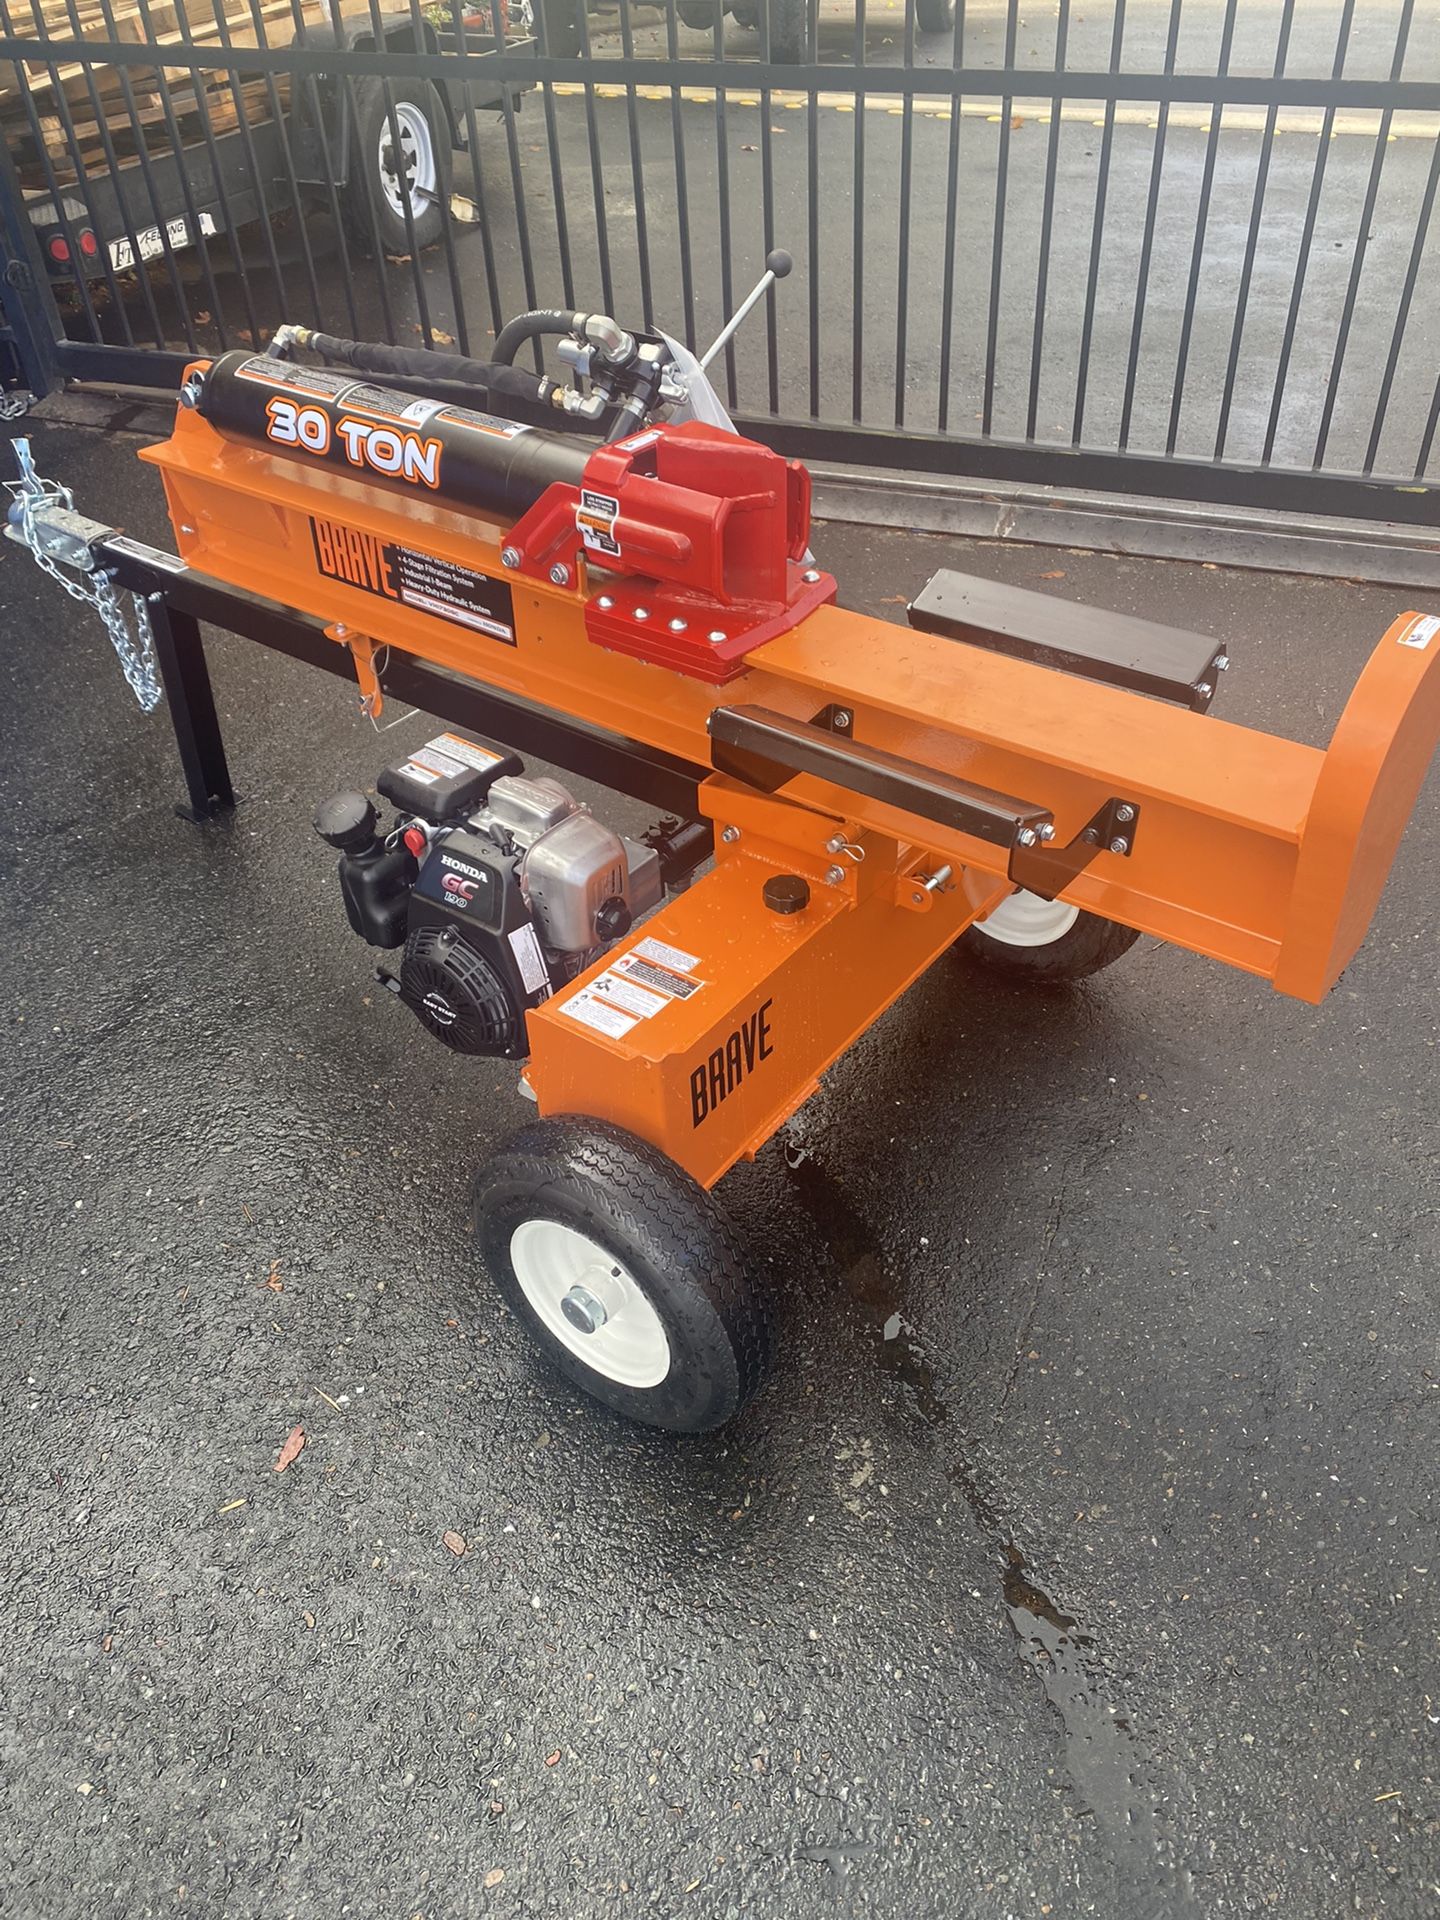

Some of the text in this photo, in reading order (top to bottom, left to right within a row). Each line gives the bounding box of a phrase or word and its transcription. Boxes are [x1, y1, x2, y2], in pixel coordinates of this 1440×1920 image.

[268, 398, 329, 453] 30
[338, 417, 441, 487] TON
[314, 517, 399, 598] BRAVE
[402, 556, 475, 588] 4-Stage Filtration System
[404, 566, 431, 583] Industrial
[456, 564, 488, 582] Operation
[405, 577, 492, 617] Heavy-Duty Hydraulic System
[440, 854, 489, 883] HONDA
[441, 872, 479, 900] GC
[444, 891, 468, 908] 190
[690, 998, 774, 1130] BRAVE
